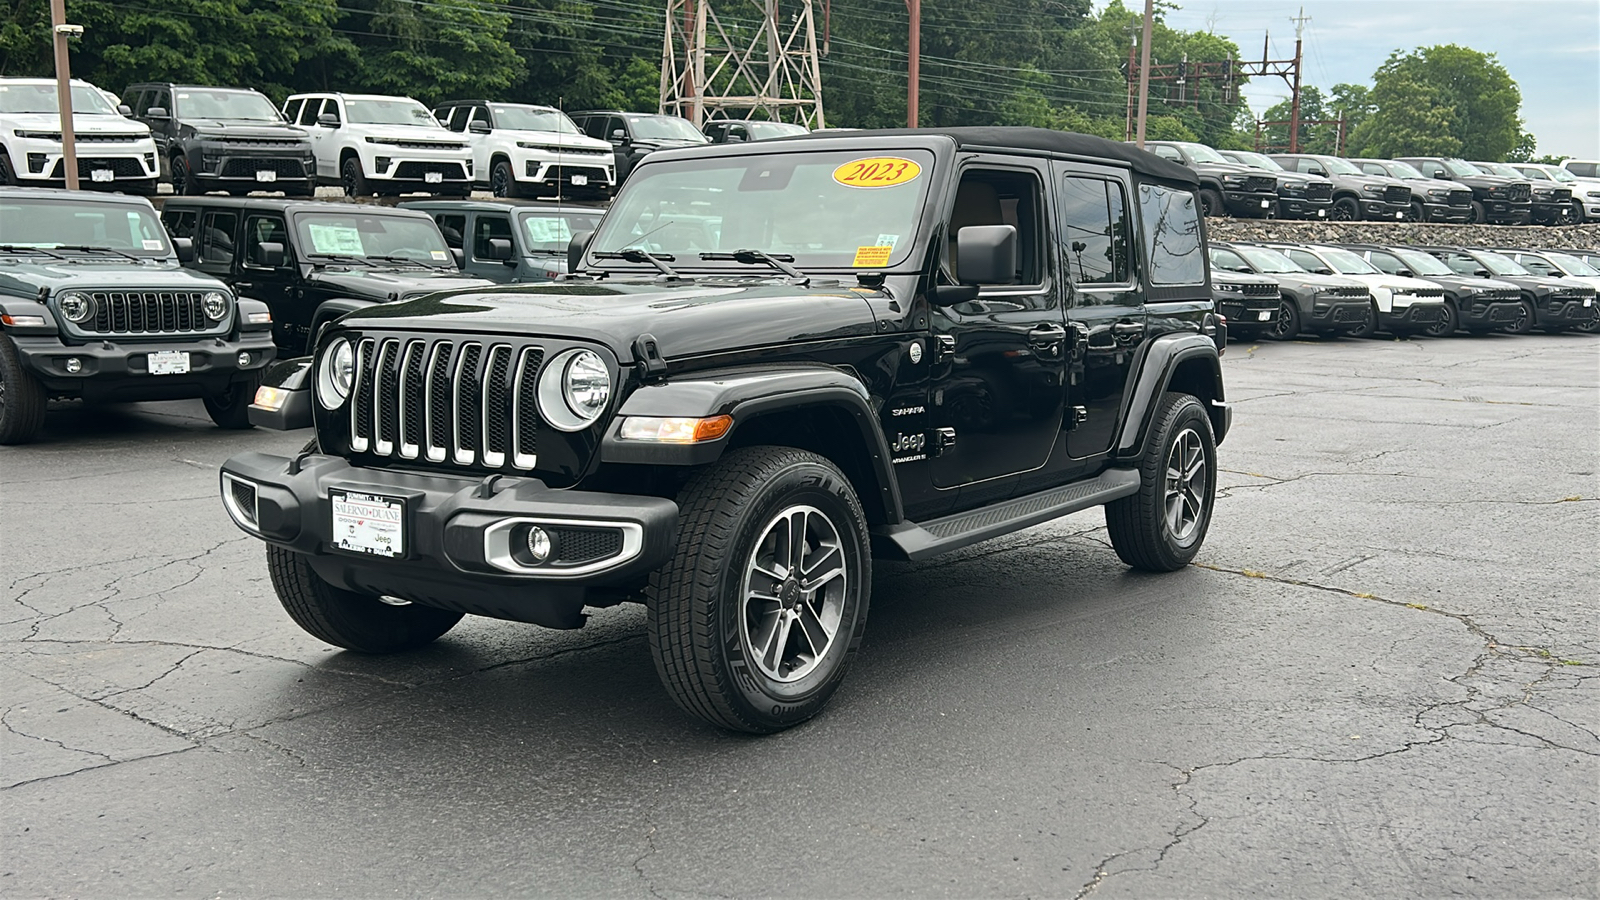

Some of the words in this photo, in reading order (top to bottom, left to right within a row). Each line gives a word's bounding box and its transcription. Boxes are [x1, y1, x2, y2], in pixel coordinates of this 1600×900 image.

[843, 163, 909, 181] 2023
[892, 406, 925, 416] SAHARA
[892, 432, 925, 452] Jeep
[335, 503, 368, 516] SALERNO
[373, 509, 400, 521] DUANE
[374, 533, 392, 544] Jeep
